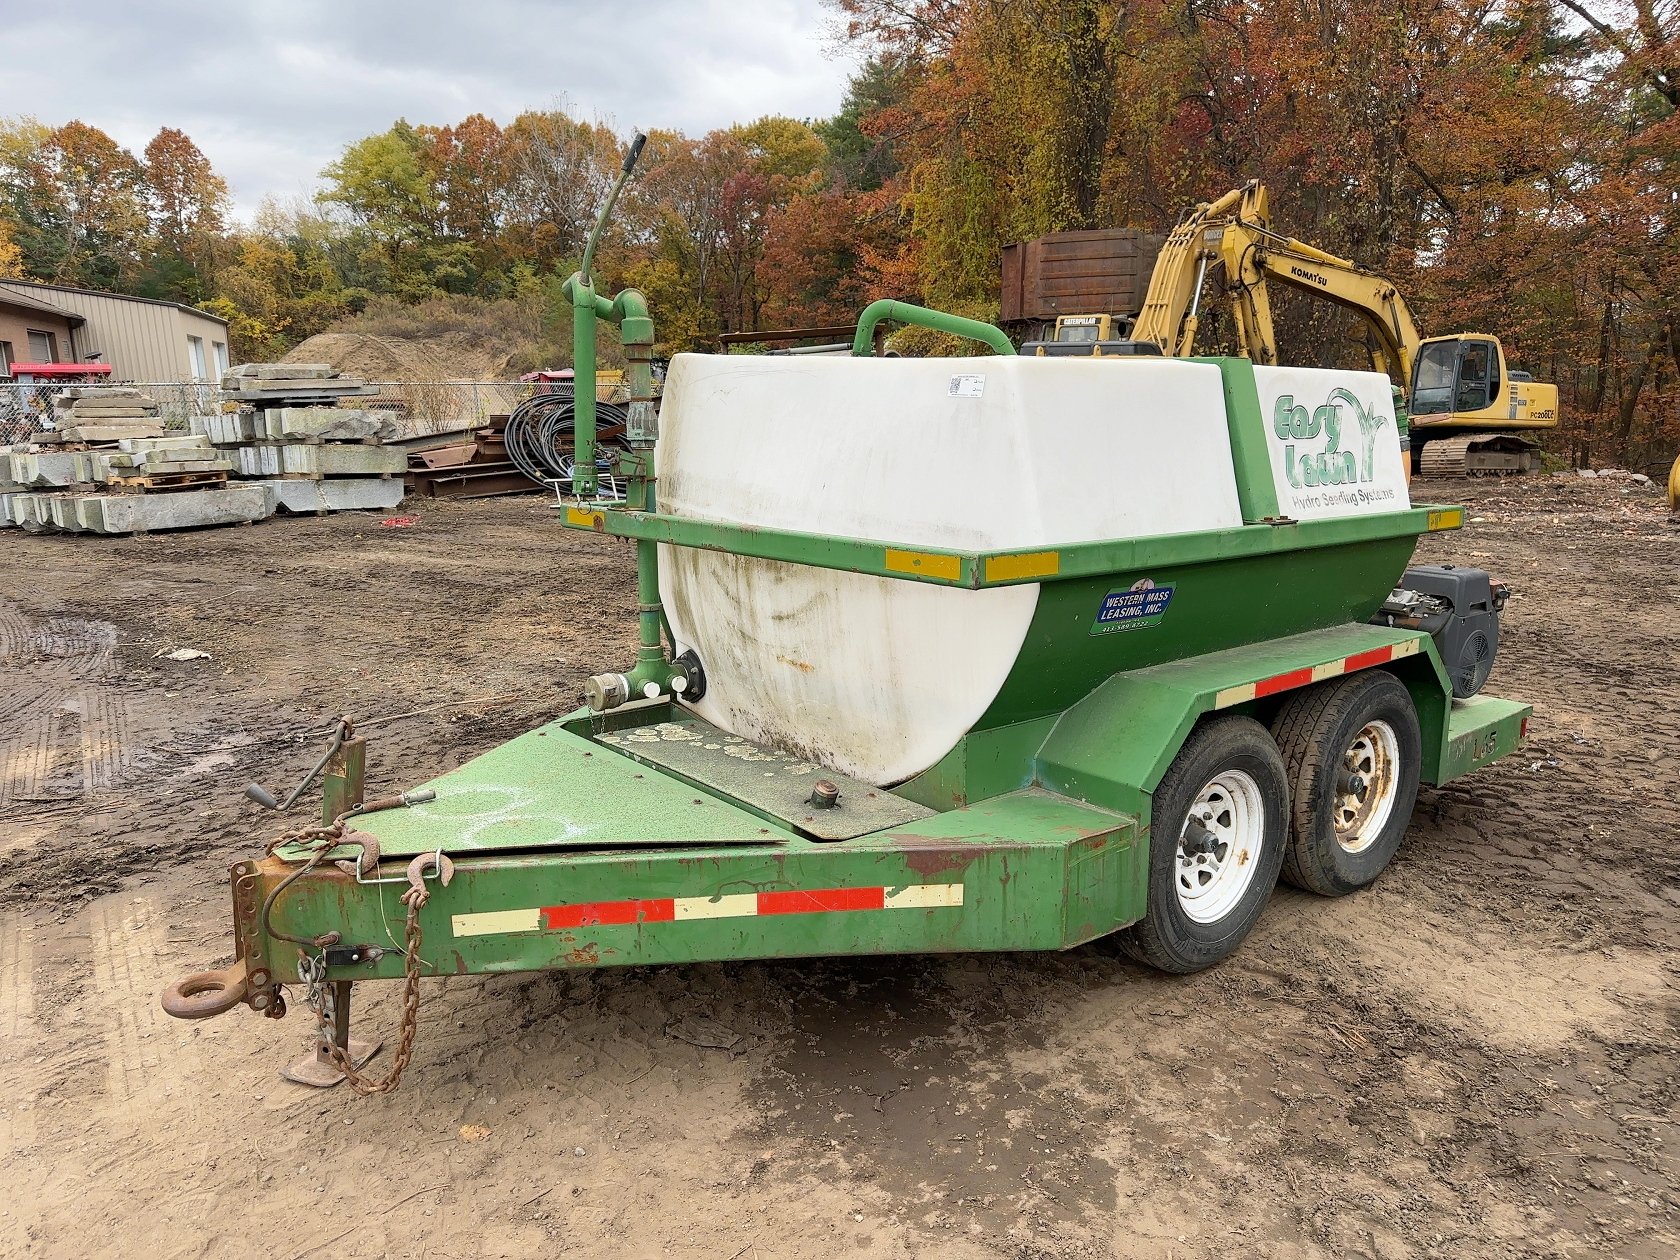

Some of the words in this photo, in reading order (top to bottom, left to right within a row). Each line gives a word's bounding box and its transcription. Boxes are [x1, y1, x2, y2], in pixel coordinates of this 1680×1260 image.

[1291, 266, 1327, 286] KOMATSU
[1274, 395, 1343, 454] Easy
[1285, 445, 1357, 489] Lawn
[1292, 494, 1321, 511] Hydro
[1321, 491, 1358, 507] Seeding
[1358, 489, 1395, 505] Systems
[1106, 594, 1145, 608] WESTERN
[1145, 591, 1170, 603] MASS
[1101, 606, 1142, 620] LEASING,
[1144, 603, 1162, 614] INC.
